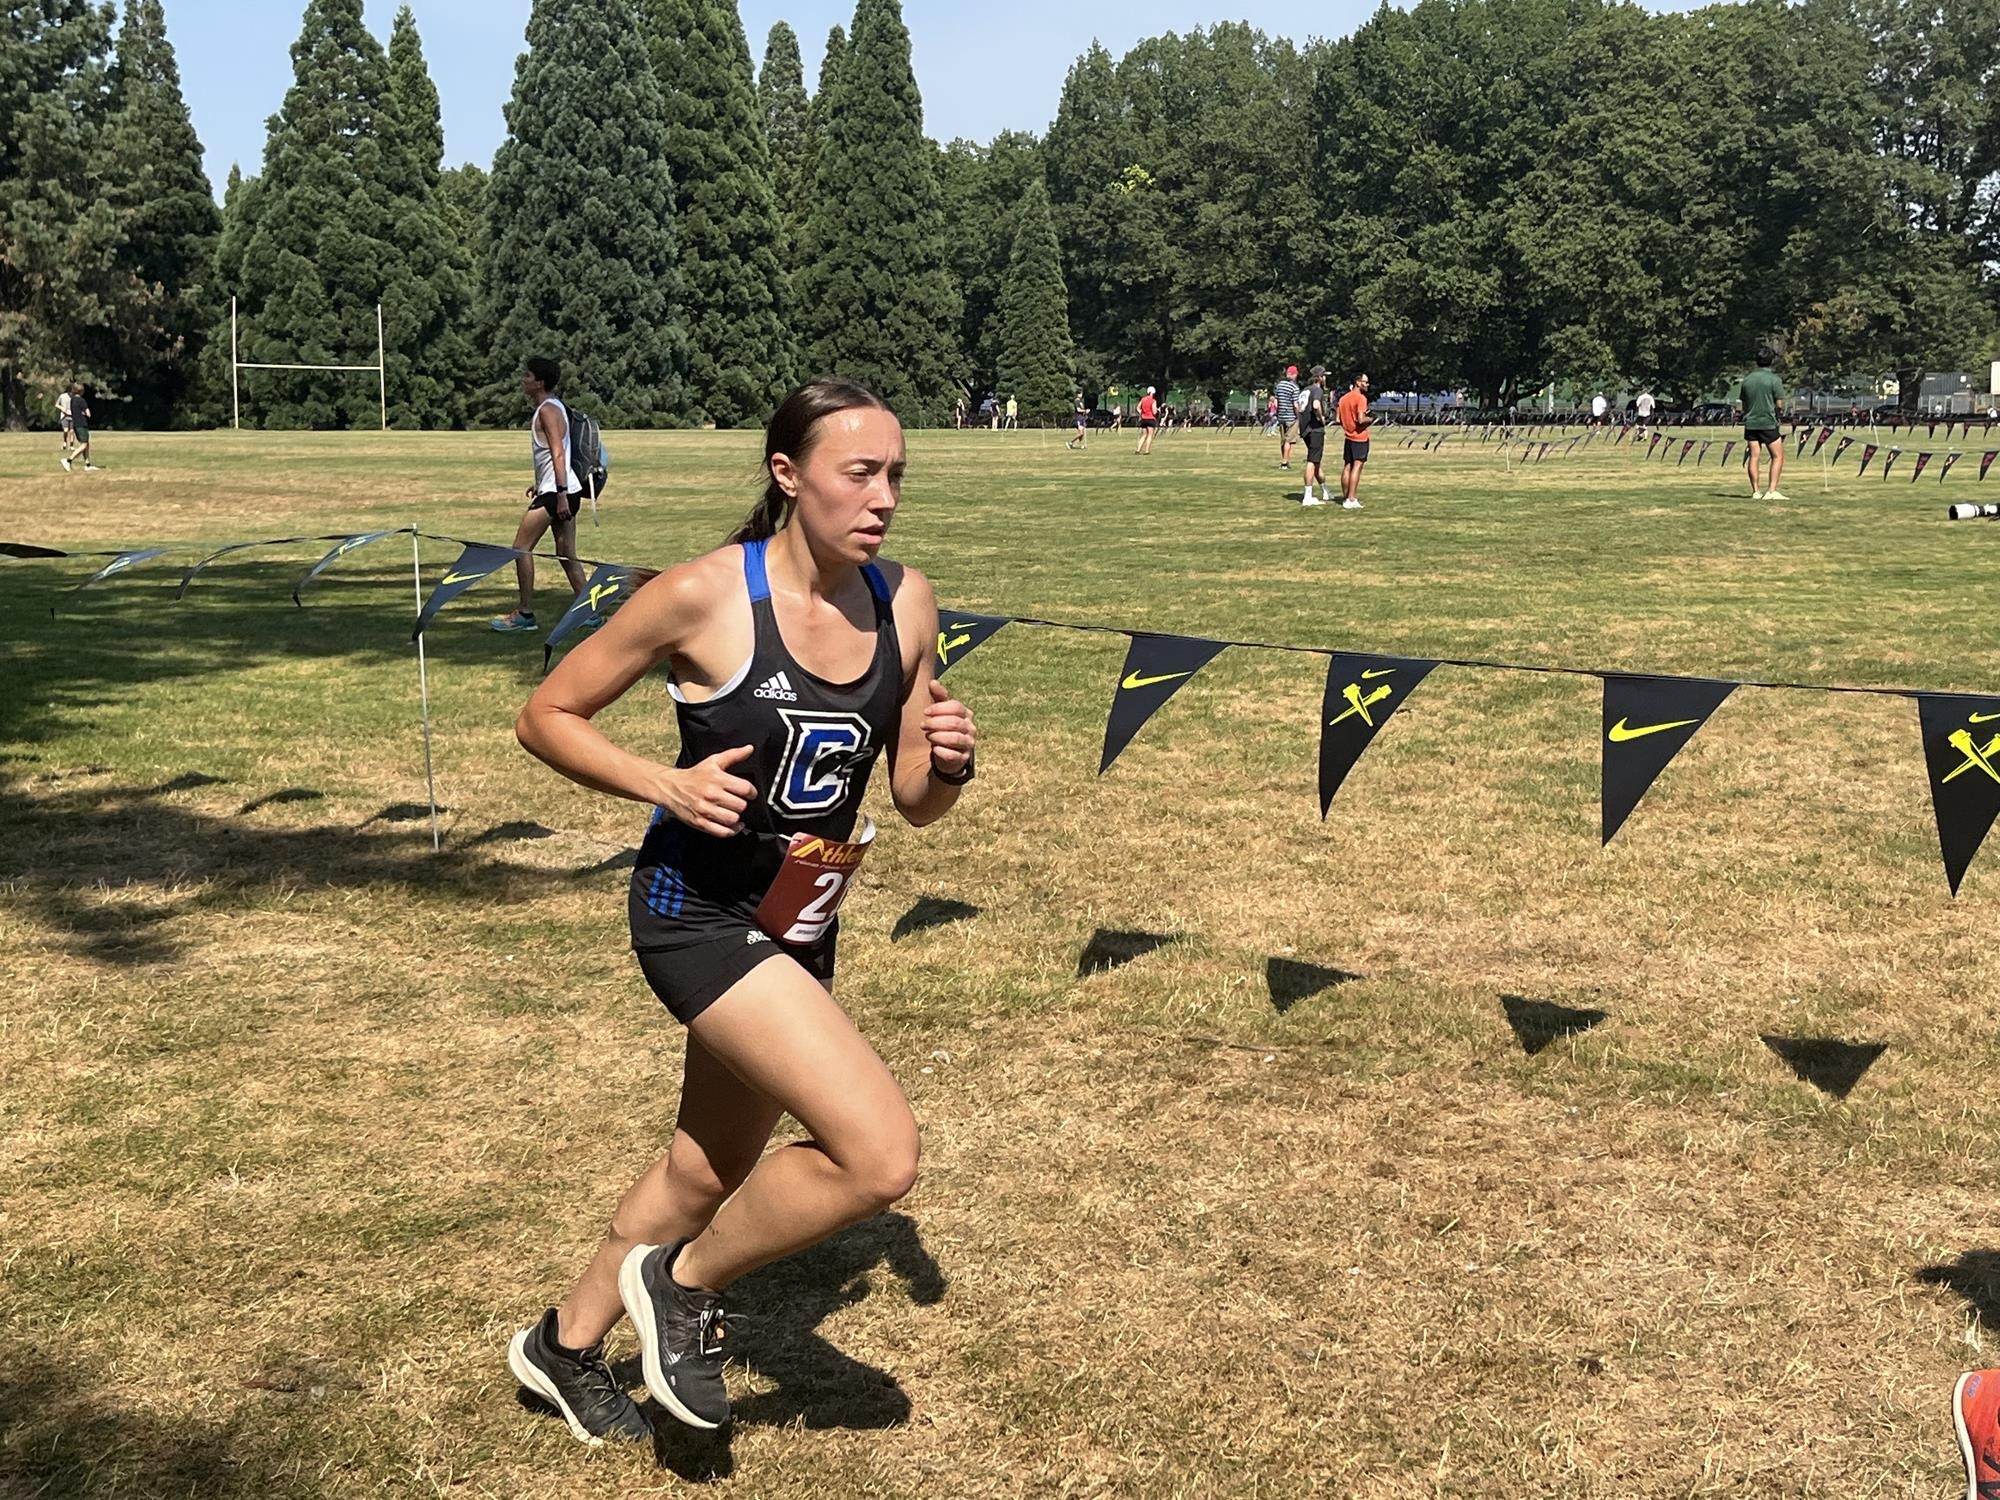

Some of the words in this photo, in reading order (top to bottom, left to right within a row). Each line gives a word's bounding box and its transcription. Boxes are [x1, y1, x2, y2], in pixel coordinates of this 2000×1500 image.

[754, 687, 798, 702] adidas
[780, 721, 862, 810] C
[791, 838, 861, 864] Athle
[796, 872, 847, 922] 2
